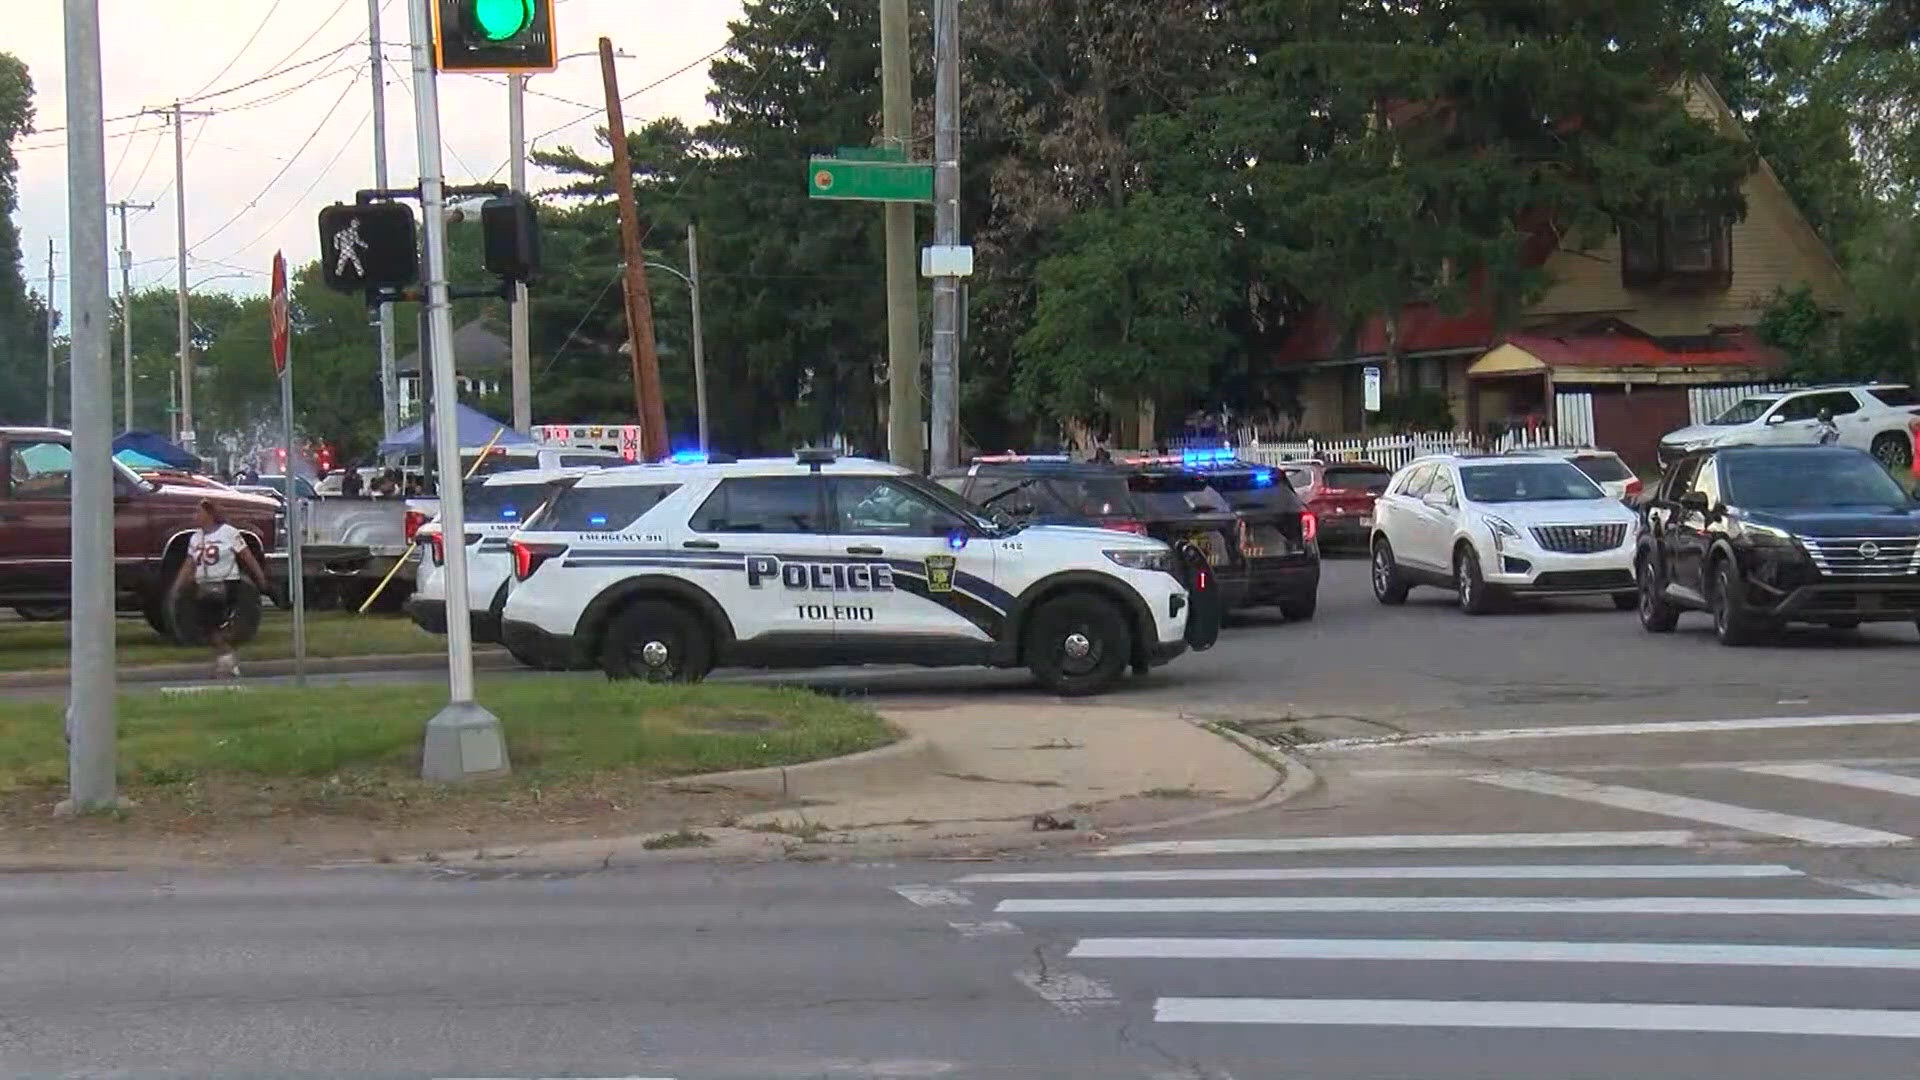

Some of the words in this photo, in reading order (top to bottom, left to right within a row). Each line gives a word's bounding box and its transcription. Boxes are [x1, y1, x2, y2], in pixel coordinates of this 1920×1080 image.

[624, 439, 638, 450] 26
[579, 534, 642, 542] EMERGENCY
[1001, 542, 1023, 550] 442
[746, 556, 894, 591] POLICE
[797, 604, 874, 622] TOLEDO
